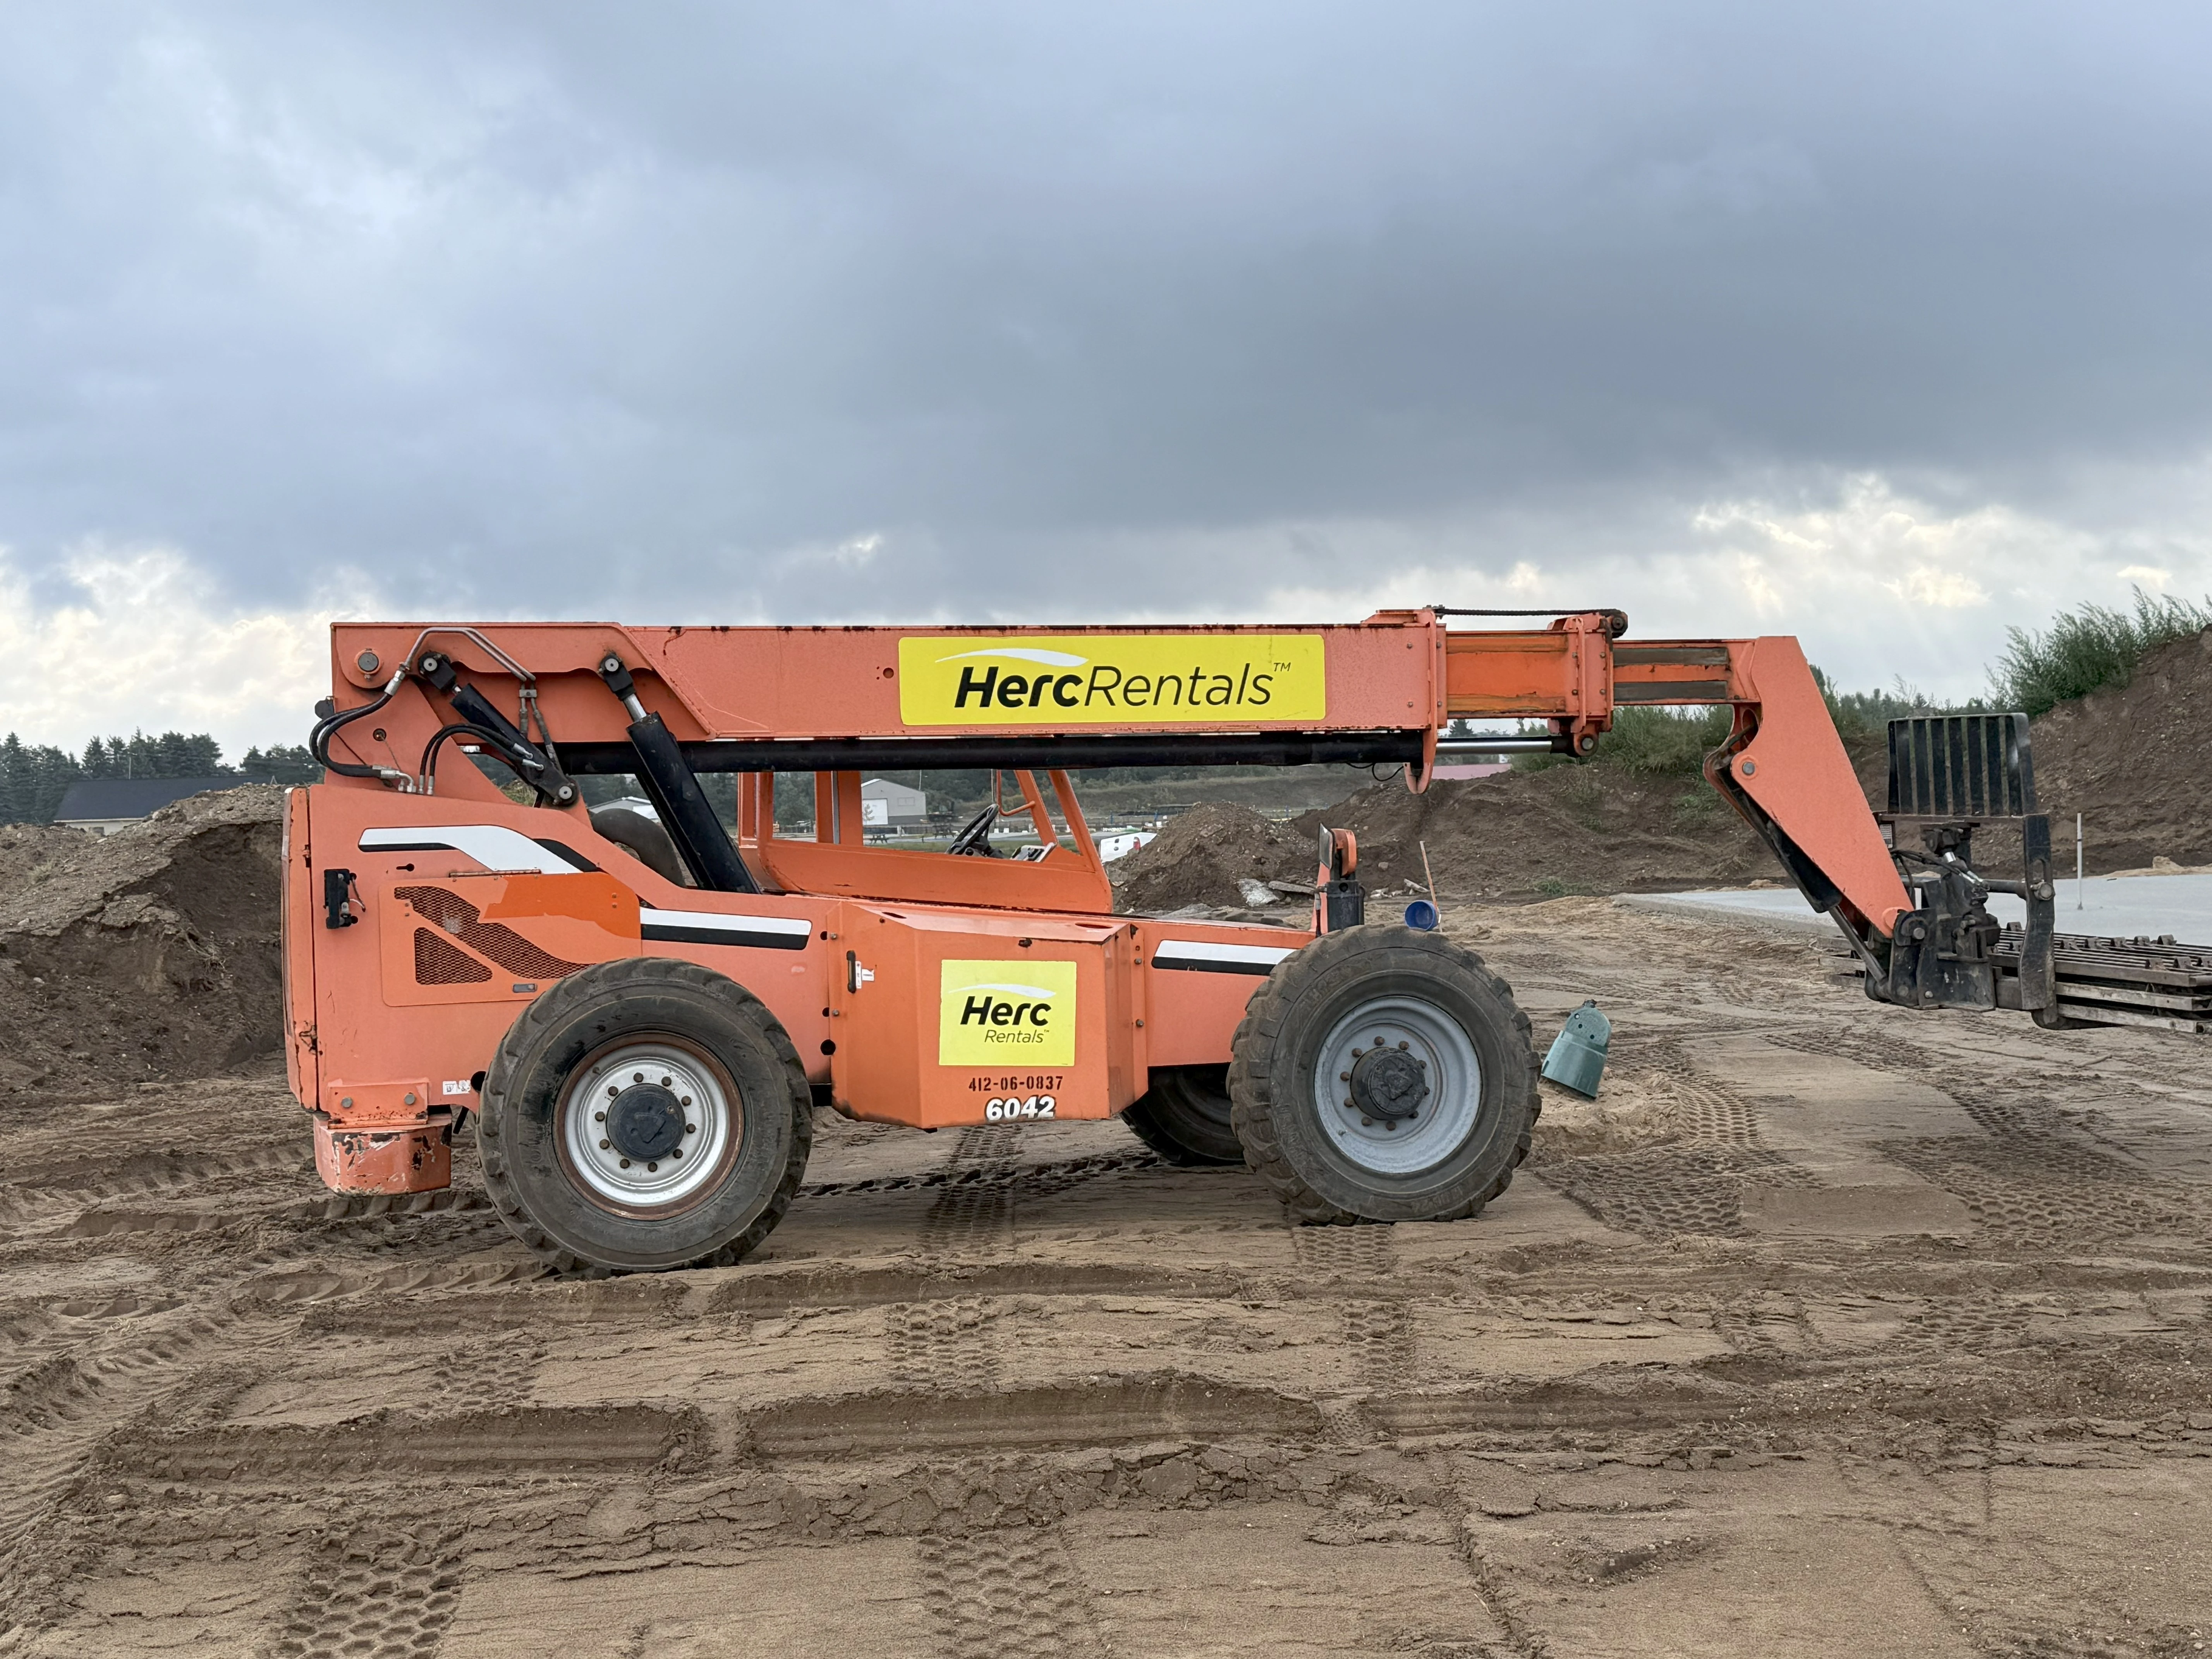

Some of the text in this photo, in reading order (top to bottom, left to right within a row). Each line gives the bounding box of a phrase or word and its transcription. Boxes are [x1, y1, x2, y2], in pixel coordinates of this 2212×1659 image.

[960, 996, 1052, 1026] Herc
[984, 1029, 1044, 1043] Rentals
[969, 1076, 1063, 1091] 412-06-0837
[985, 1095, 1056, 1121] 6042
